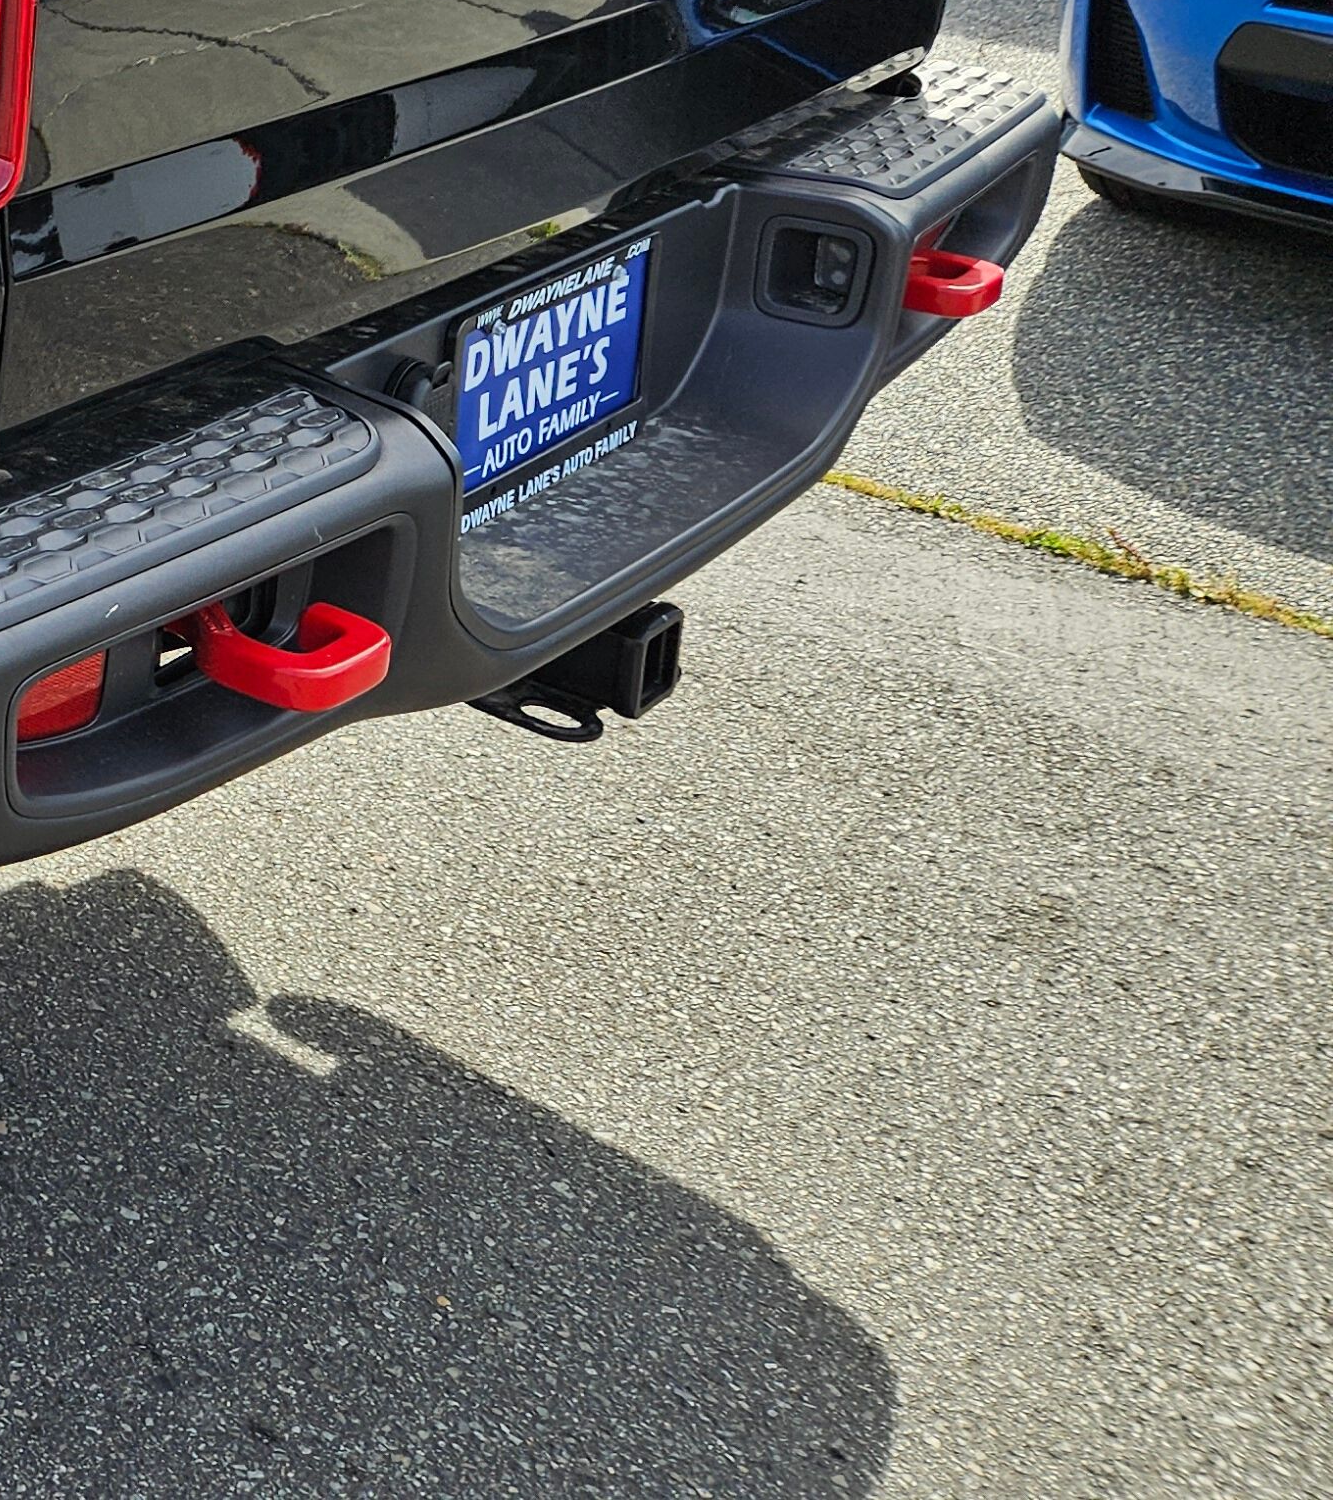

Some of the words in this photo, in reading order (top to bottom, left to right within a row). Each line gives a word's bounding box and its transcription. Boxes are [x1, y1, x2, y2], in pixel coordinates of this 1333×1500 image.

[463, 274, 629, 393] DWAYNE
[507, 255, 616, 321] DWAYNELANE
[478, 336, 610, 442] LANE'S
[482, 427, 532, 478] AUTO
[538, 390, 602, 445] FAMILY
[460, 488, 516, 534] DWAYNE
[518, 465, 561, 503] LANE'S
[562, 444, 594, 479] AUTO
[594, 420, 638, 462] FAMILY
